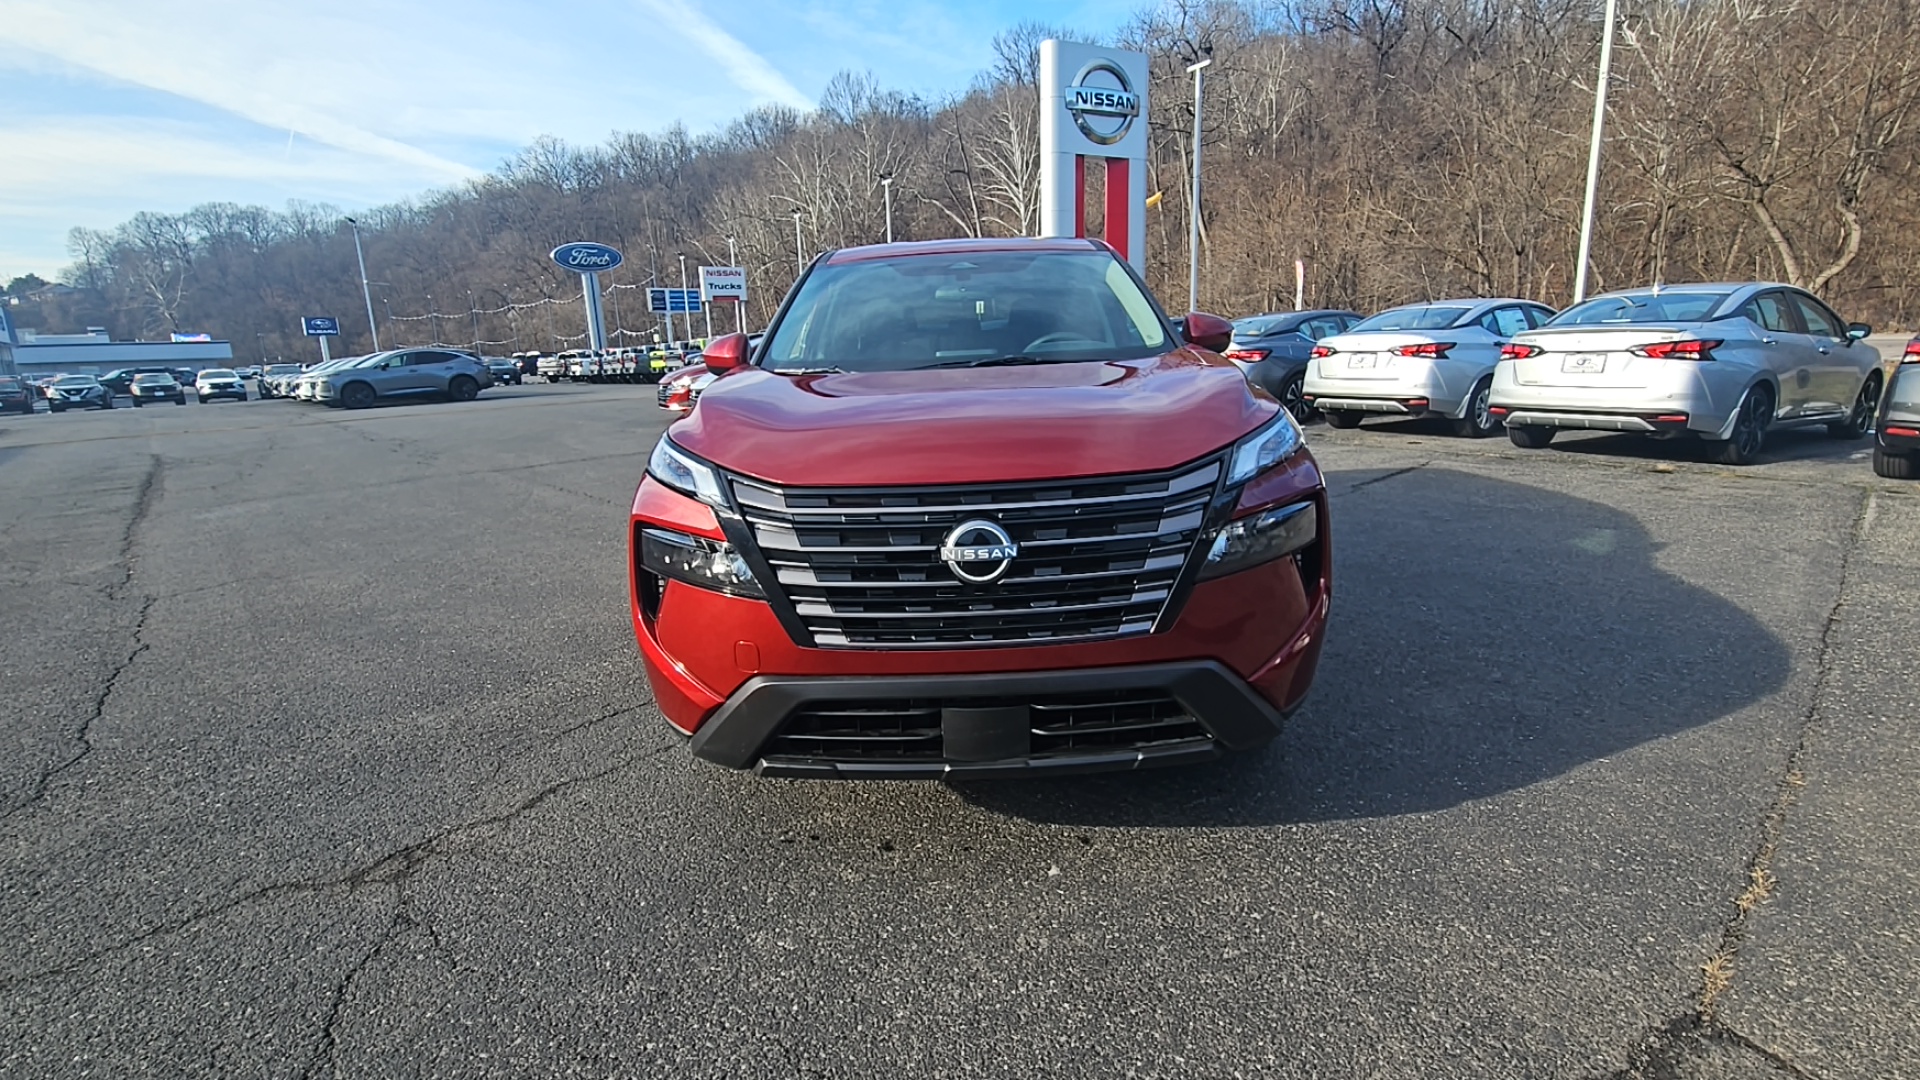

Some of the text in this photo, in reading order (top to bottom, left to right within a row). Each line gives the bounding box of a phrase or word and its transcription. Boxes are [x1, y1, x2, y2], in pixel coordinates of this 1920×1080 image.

[1076, 91, 1135, 110] NISSAN
[569, 248, 609, 265] Ford
[943, 547, 1017, 560] NISSAN
